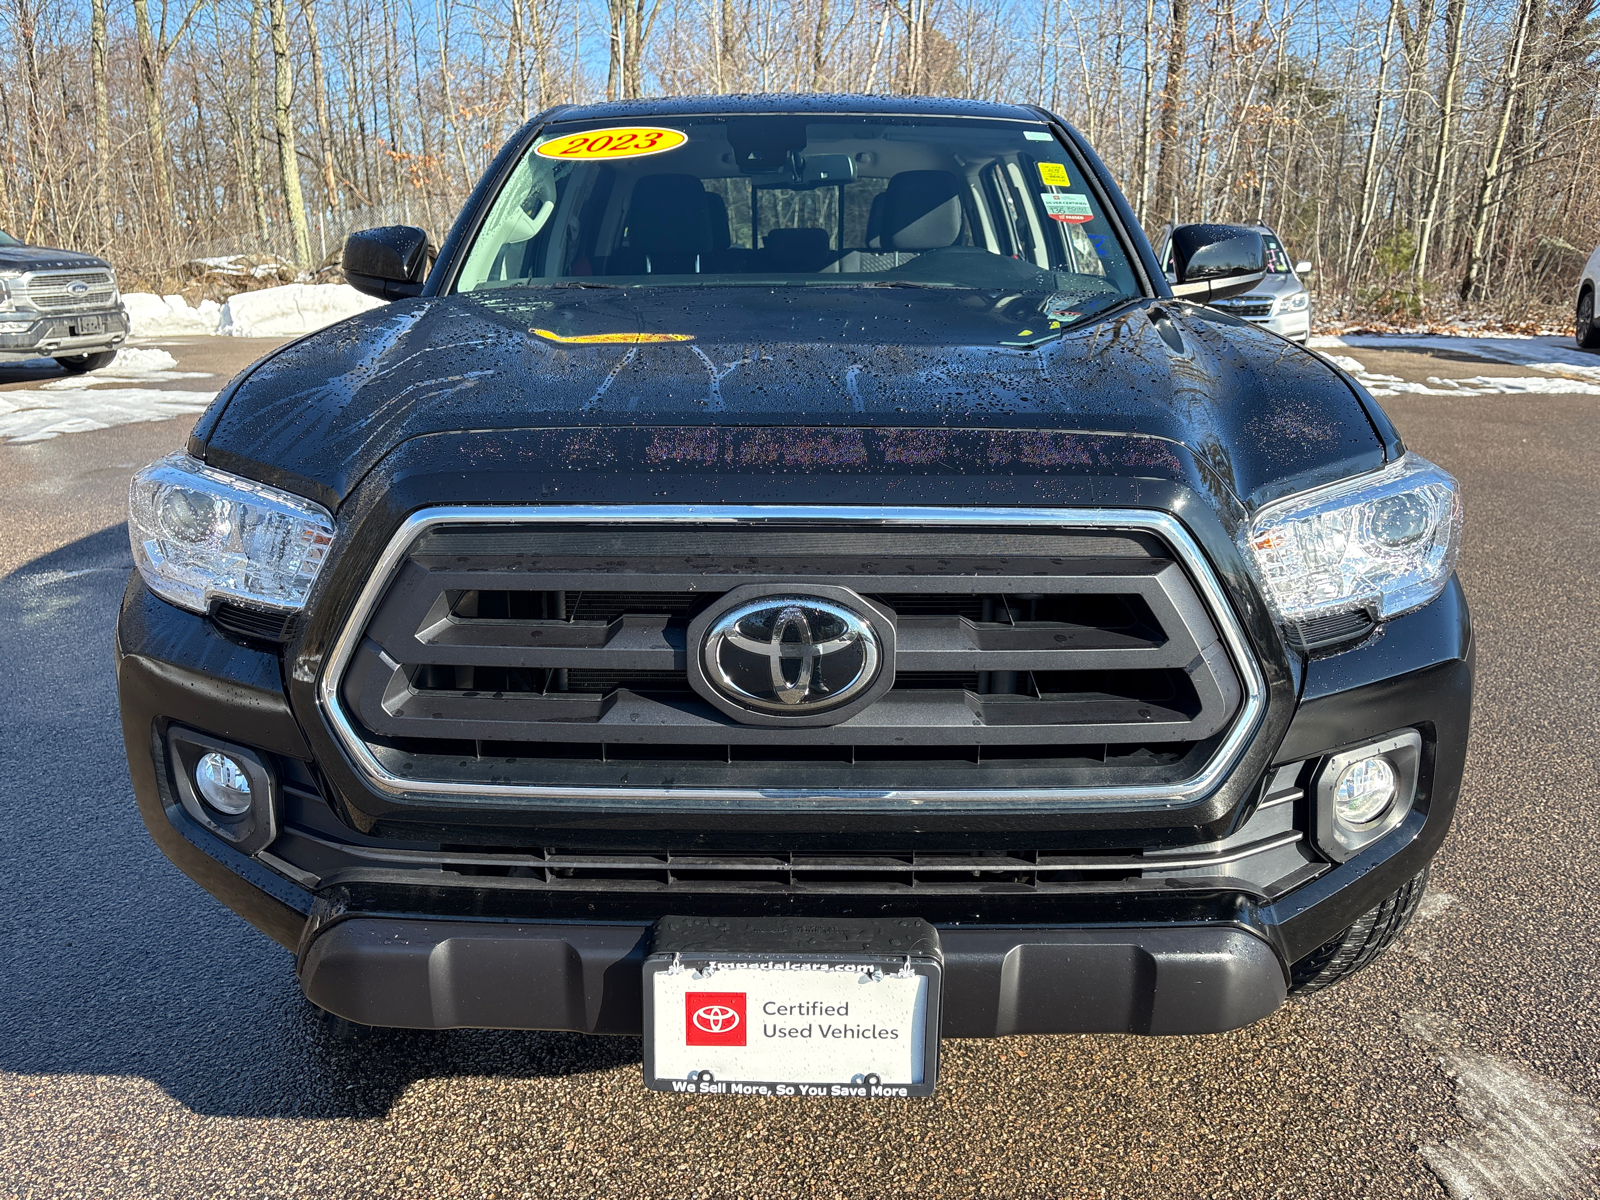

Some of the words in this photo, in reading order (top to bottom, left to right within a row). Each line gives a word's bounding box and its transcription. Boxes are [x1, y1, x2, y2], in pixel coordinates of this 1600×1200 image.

[559, 132, 664, 155] 2023
[35, 260, 98, 268] LIMITED
[762, 1001, 849, 1017] Certified
[763, 1023, 812, 1039] Used
[818, 1024, 899, 1040] Vehicles
[672, 1081, 696, 1093] We
[699, 1082, 726, 1094] Sell
[730, 1083, 772, 1097] More,
[776, 1084, 795, 1096] So
[799, 1085, 827, 1096] You
[831, 1085, 867, 1097] Save
[871, 1085, 907, 1097] More
